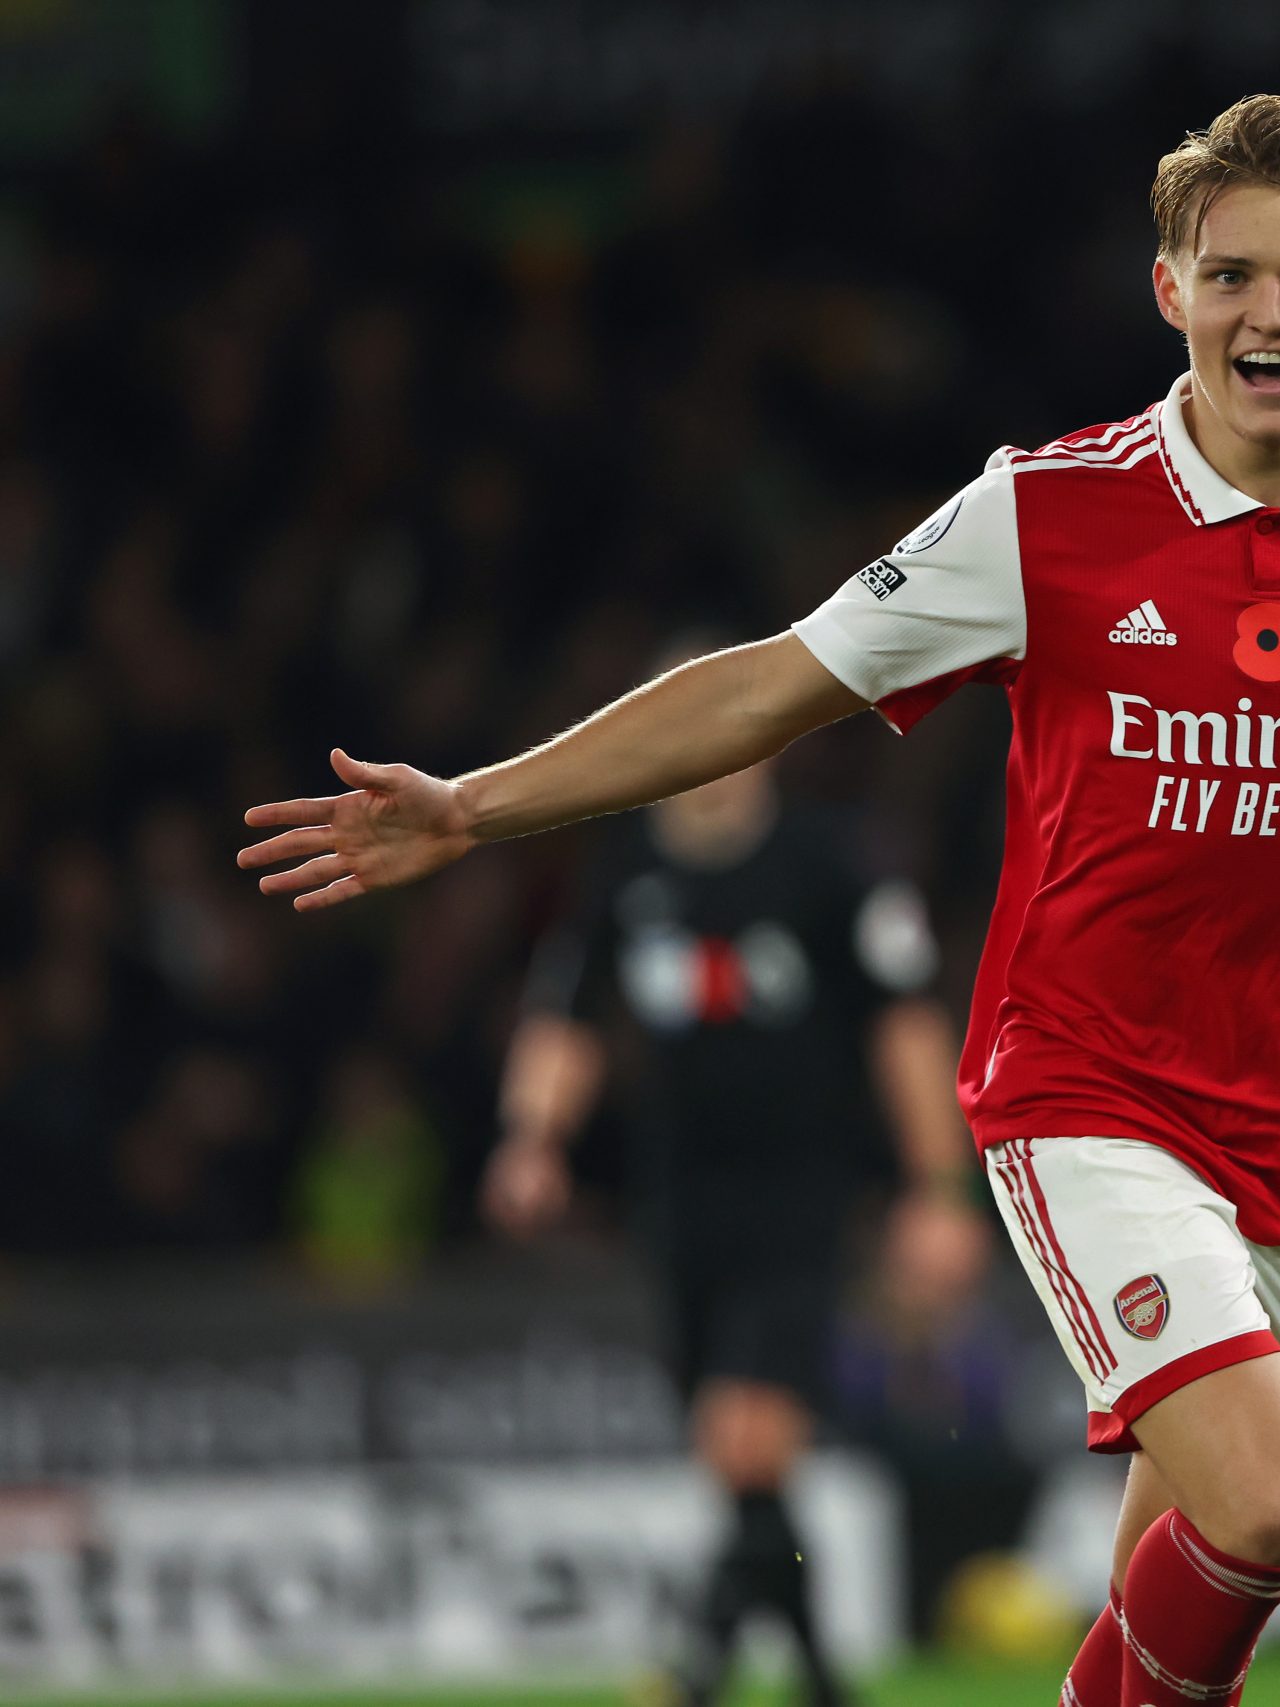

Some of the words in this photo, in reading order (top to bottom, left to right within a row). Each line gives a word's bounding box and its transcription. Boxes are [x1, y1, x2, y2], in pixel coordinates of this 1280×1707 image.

[1108, 626, 1178, 647] adidas
[1147, 775, 1222, 834] FLY
[1120, 1281, 1158, 1311] Arsenal
